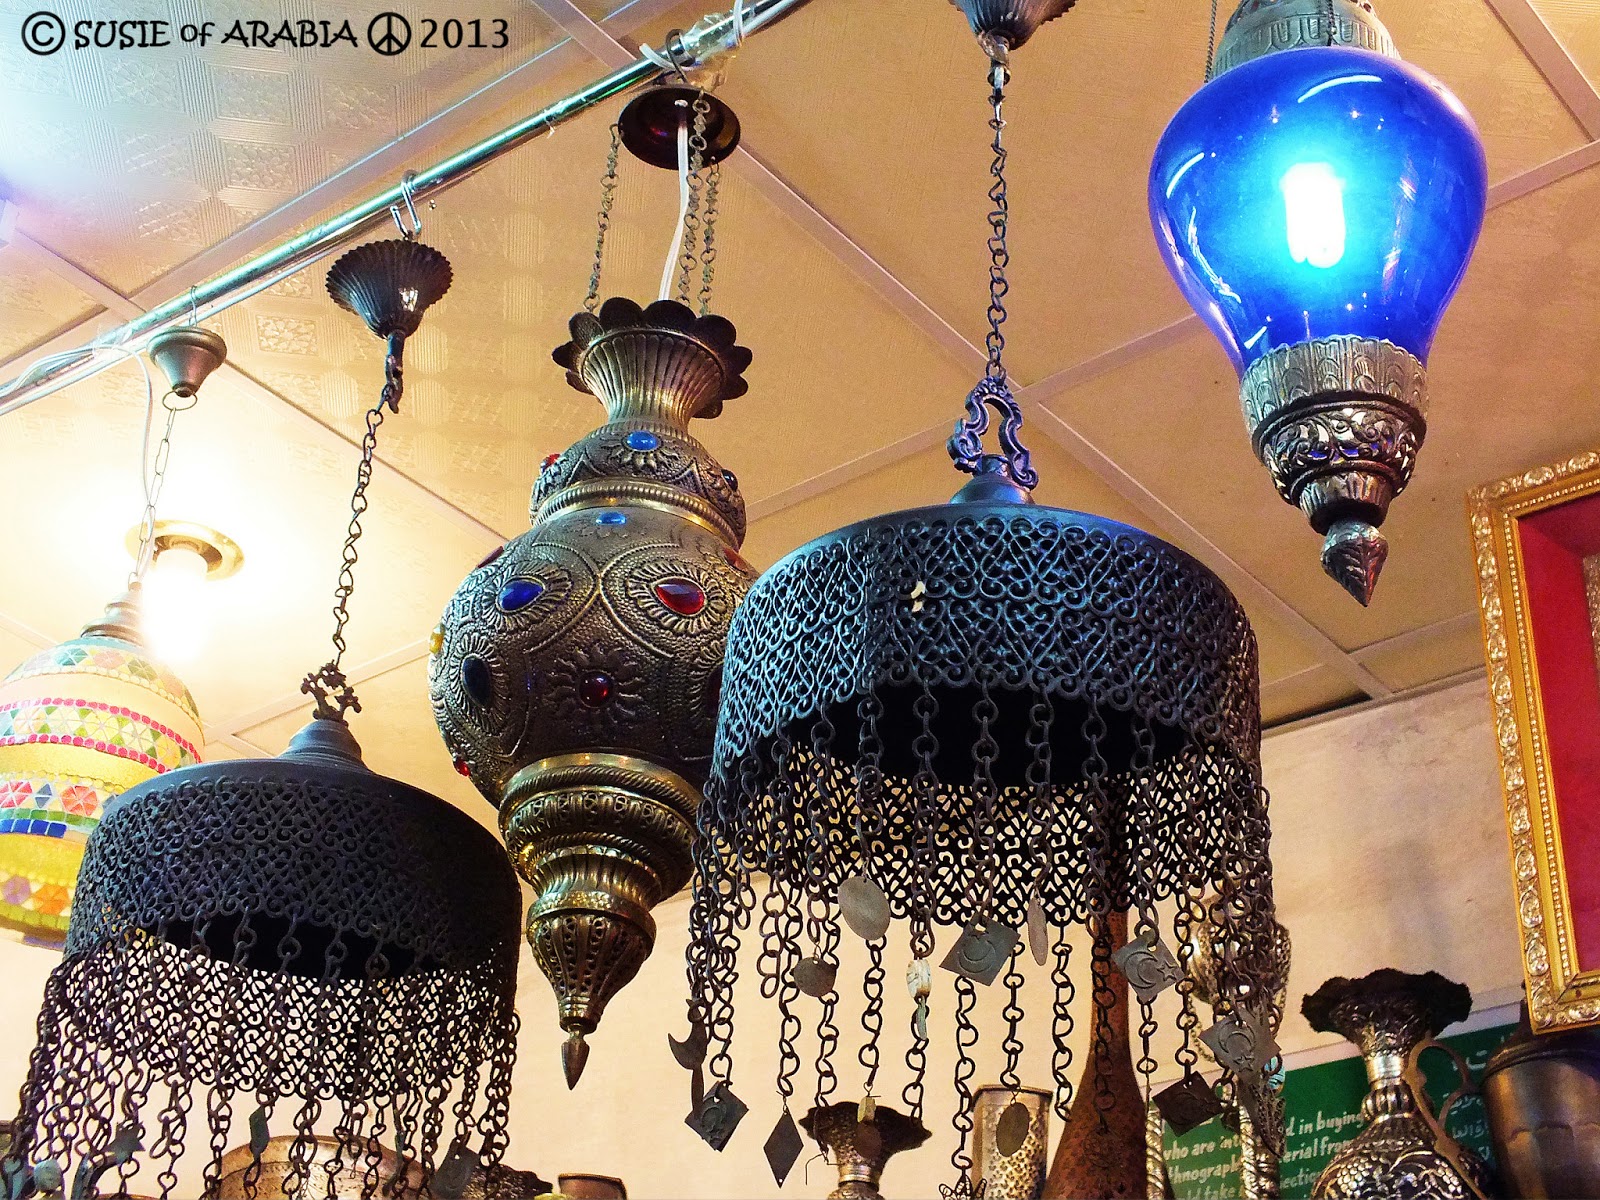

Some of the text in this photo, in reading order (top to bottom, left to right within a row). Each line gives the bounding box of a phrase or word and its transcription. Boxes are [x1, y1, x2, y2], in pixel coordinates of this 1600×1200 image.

[1191, 1141, 1216, 1156] are
[1298, 1119, 1313, 1135] in
[1315, 1110, 1364, 1133] buying
